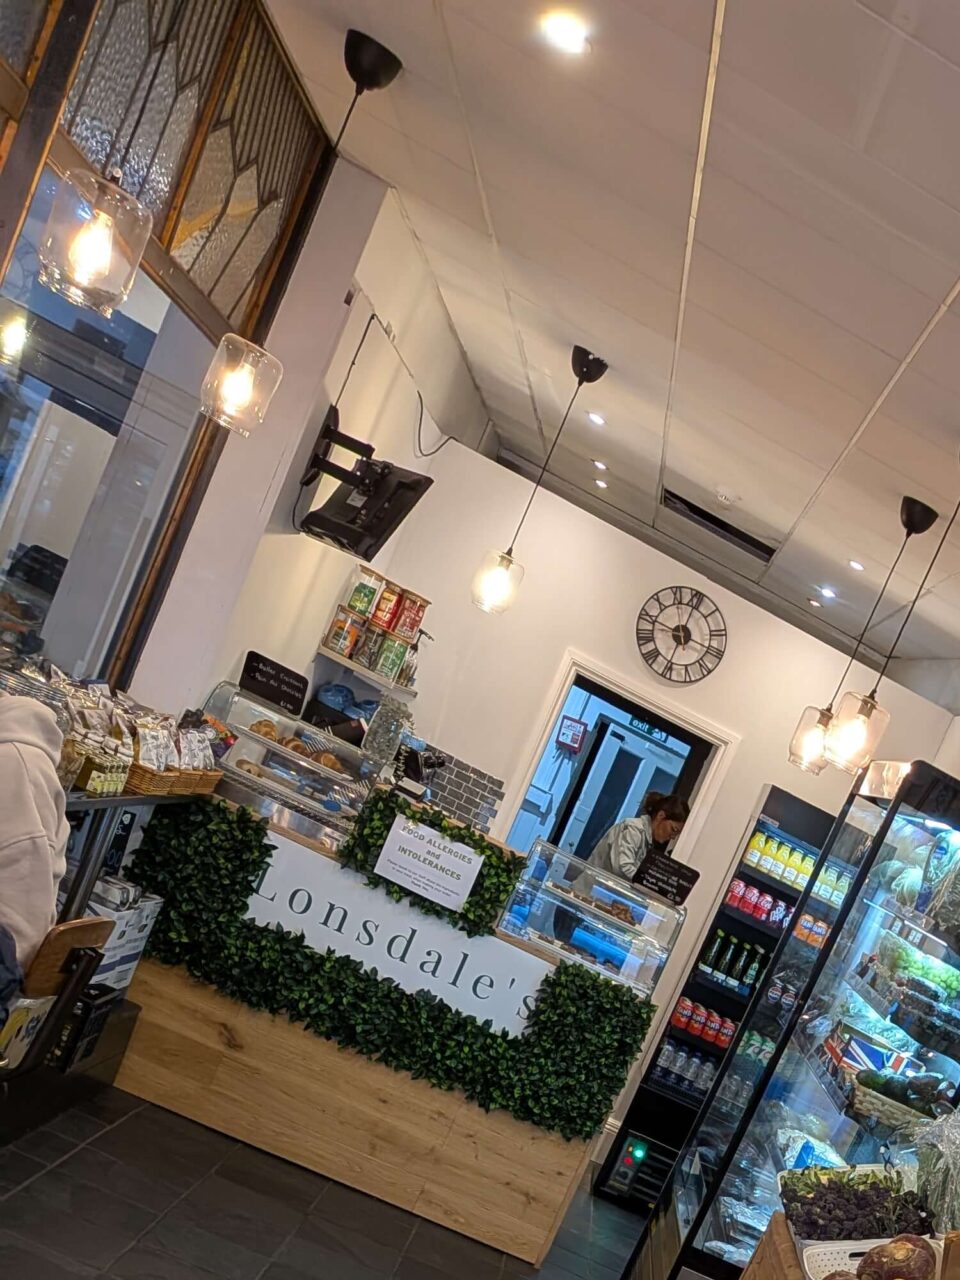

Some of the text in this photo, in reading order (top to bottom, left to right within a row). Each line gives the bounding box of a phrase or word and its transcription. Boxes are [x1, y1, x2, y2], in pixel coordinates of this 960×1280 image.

[632, 719, 650, 732] exit
[398, 845, 462, 880] INTOLERANCES
[402, 826, 472, 864] FOOD ALLERGIES
[426, 850, 441, 860] and
[252, 864, 536, 1020] Lonsdale's
